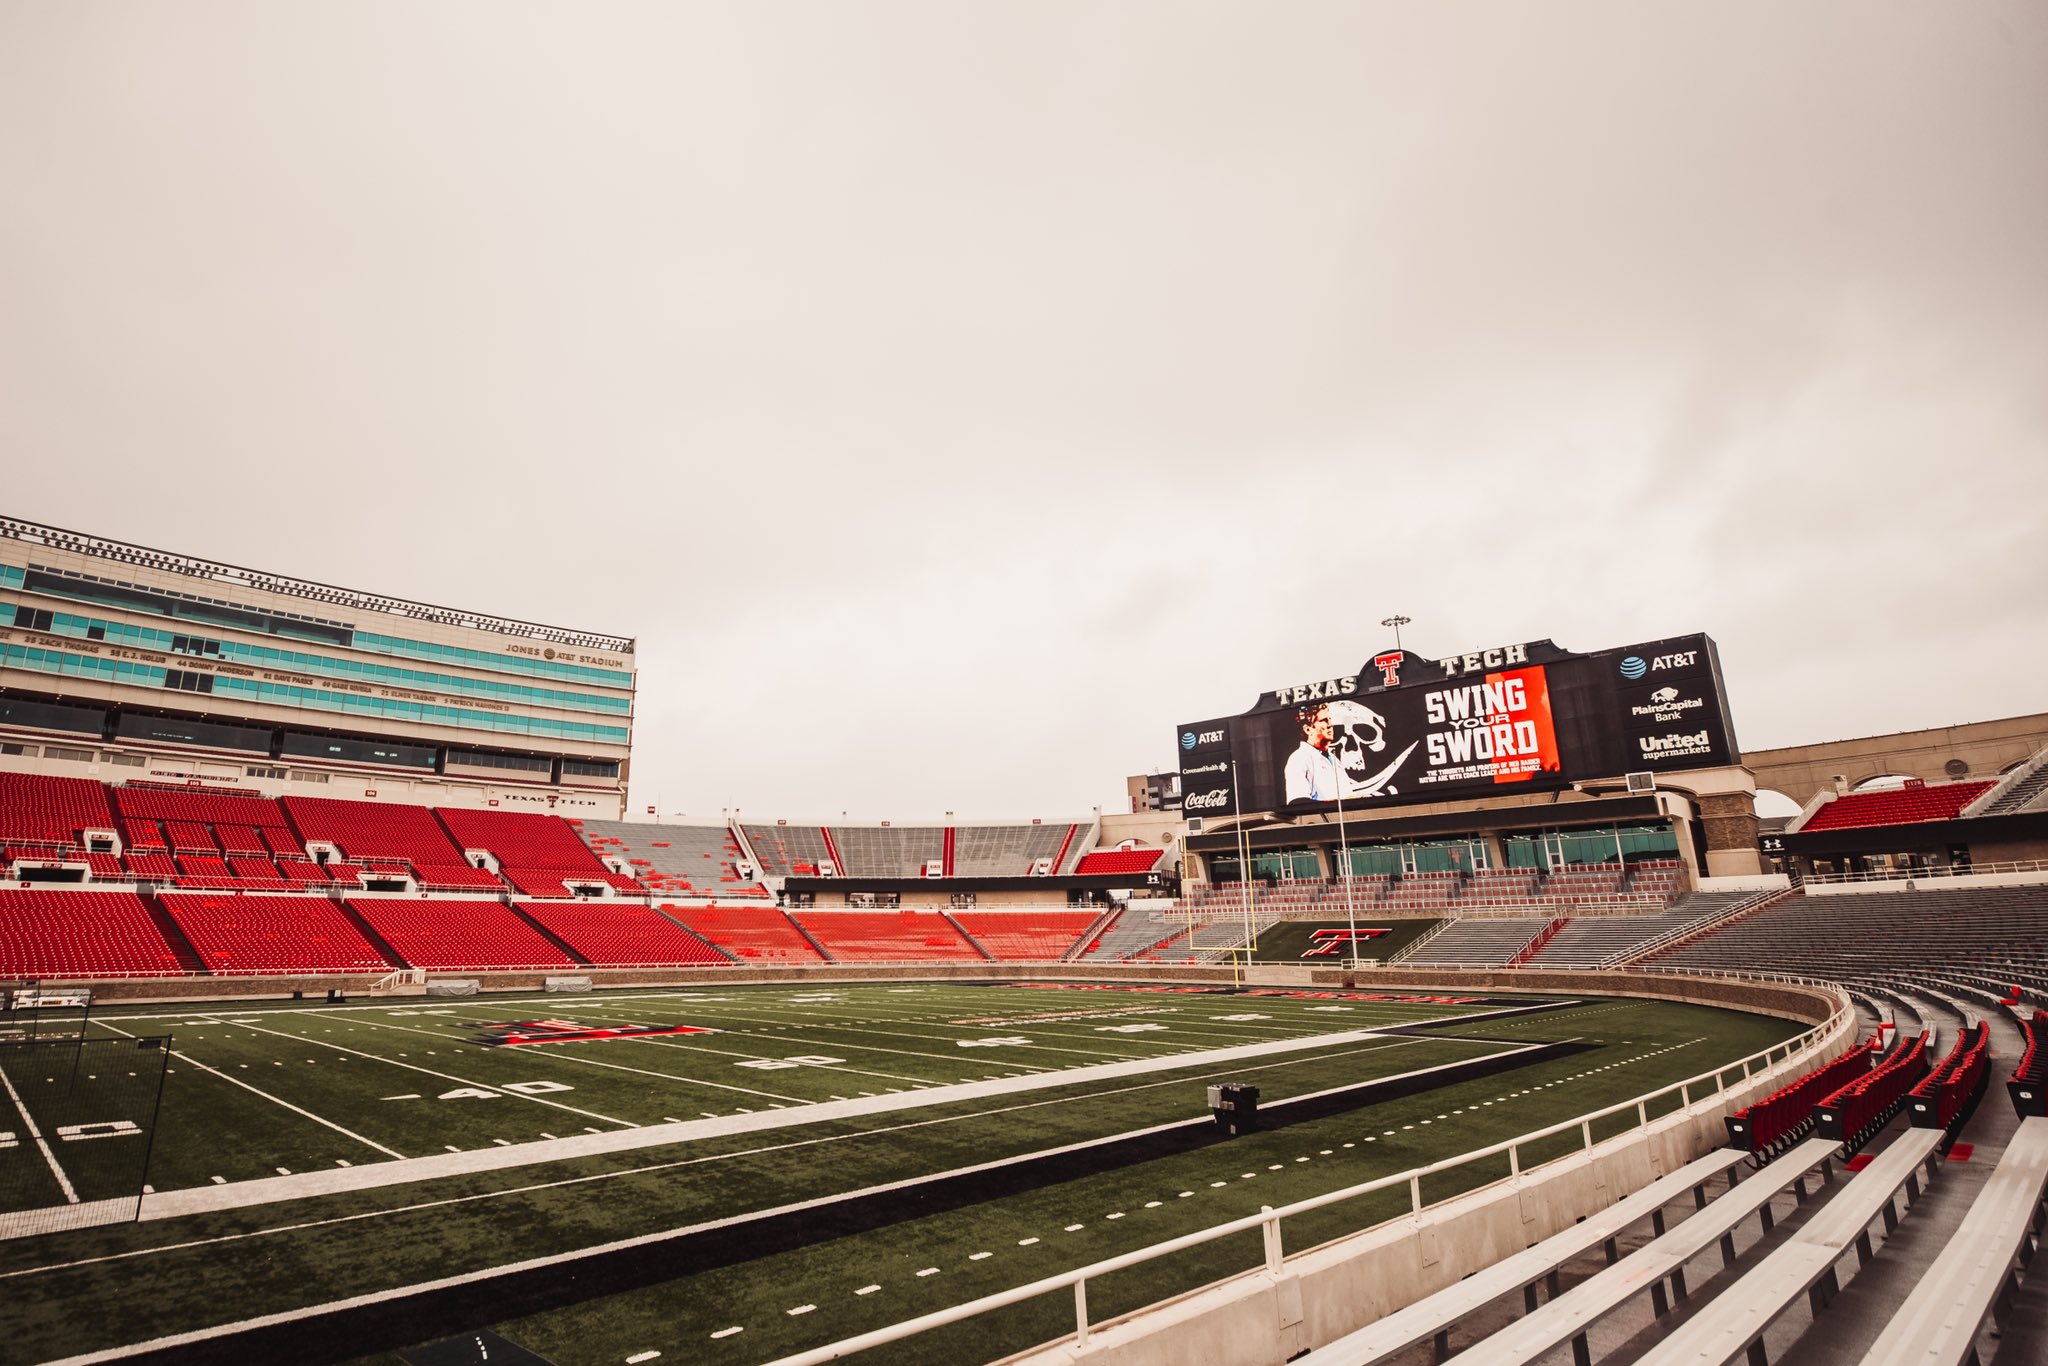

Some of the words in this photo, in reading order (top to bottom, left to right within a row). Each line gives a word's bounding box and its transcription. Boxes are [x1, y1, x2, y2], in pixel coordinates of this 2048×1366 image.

[39, 638, 61, 647] ZACH
[64, 642, 100, 653] THOMAS
[140, 654, 166, 664] HOLUB
[505, 644, 539, 656] JONES
[556, 652, 576, 661] AT&T
[579, 655, 623, 668] STADIUM
[1652, 650, 1697, 671] AT&T
[188, 661, 214, 671] DONNY
[216, 665, 255, 677] ANDERSON
[1276, 676, 1358, 707] TEXAS
[1440, 644, 1529, 677] TECH
[292, 676, 313, 686] PARKS
[1425, 678, 1527, 724] SWING
[1632, 698, 1703, 716] PlainsCapital
[1449, 714, 1510, 729] YOUR
[1655, 711, 1682, 722] Bank
[1198, 730, 1224, 744] AT&T
[1426, 720, 1539, 765] SWORD
[1639, 730, 1710, 752] United
[1642, 745, 1711, 760] supermarkets
[1438, 767, 1464, 775] THOUGHTS
[1477, 763, 1500, 771] PRAYERS
[1463, 771, 1480, 779] COACH
[1480, 769, 1498, 777] LEACH
[504, 794, 545, 802] TEXAS
[733, 1055, 847, 1070] 50
[437, 1080, 576, 1100] 40
